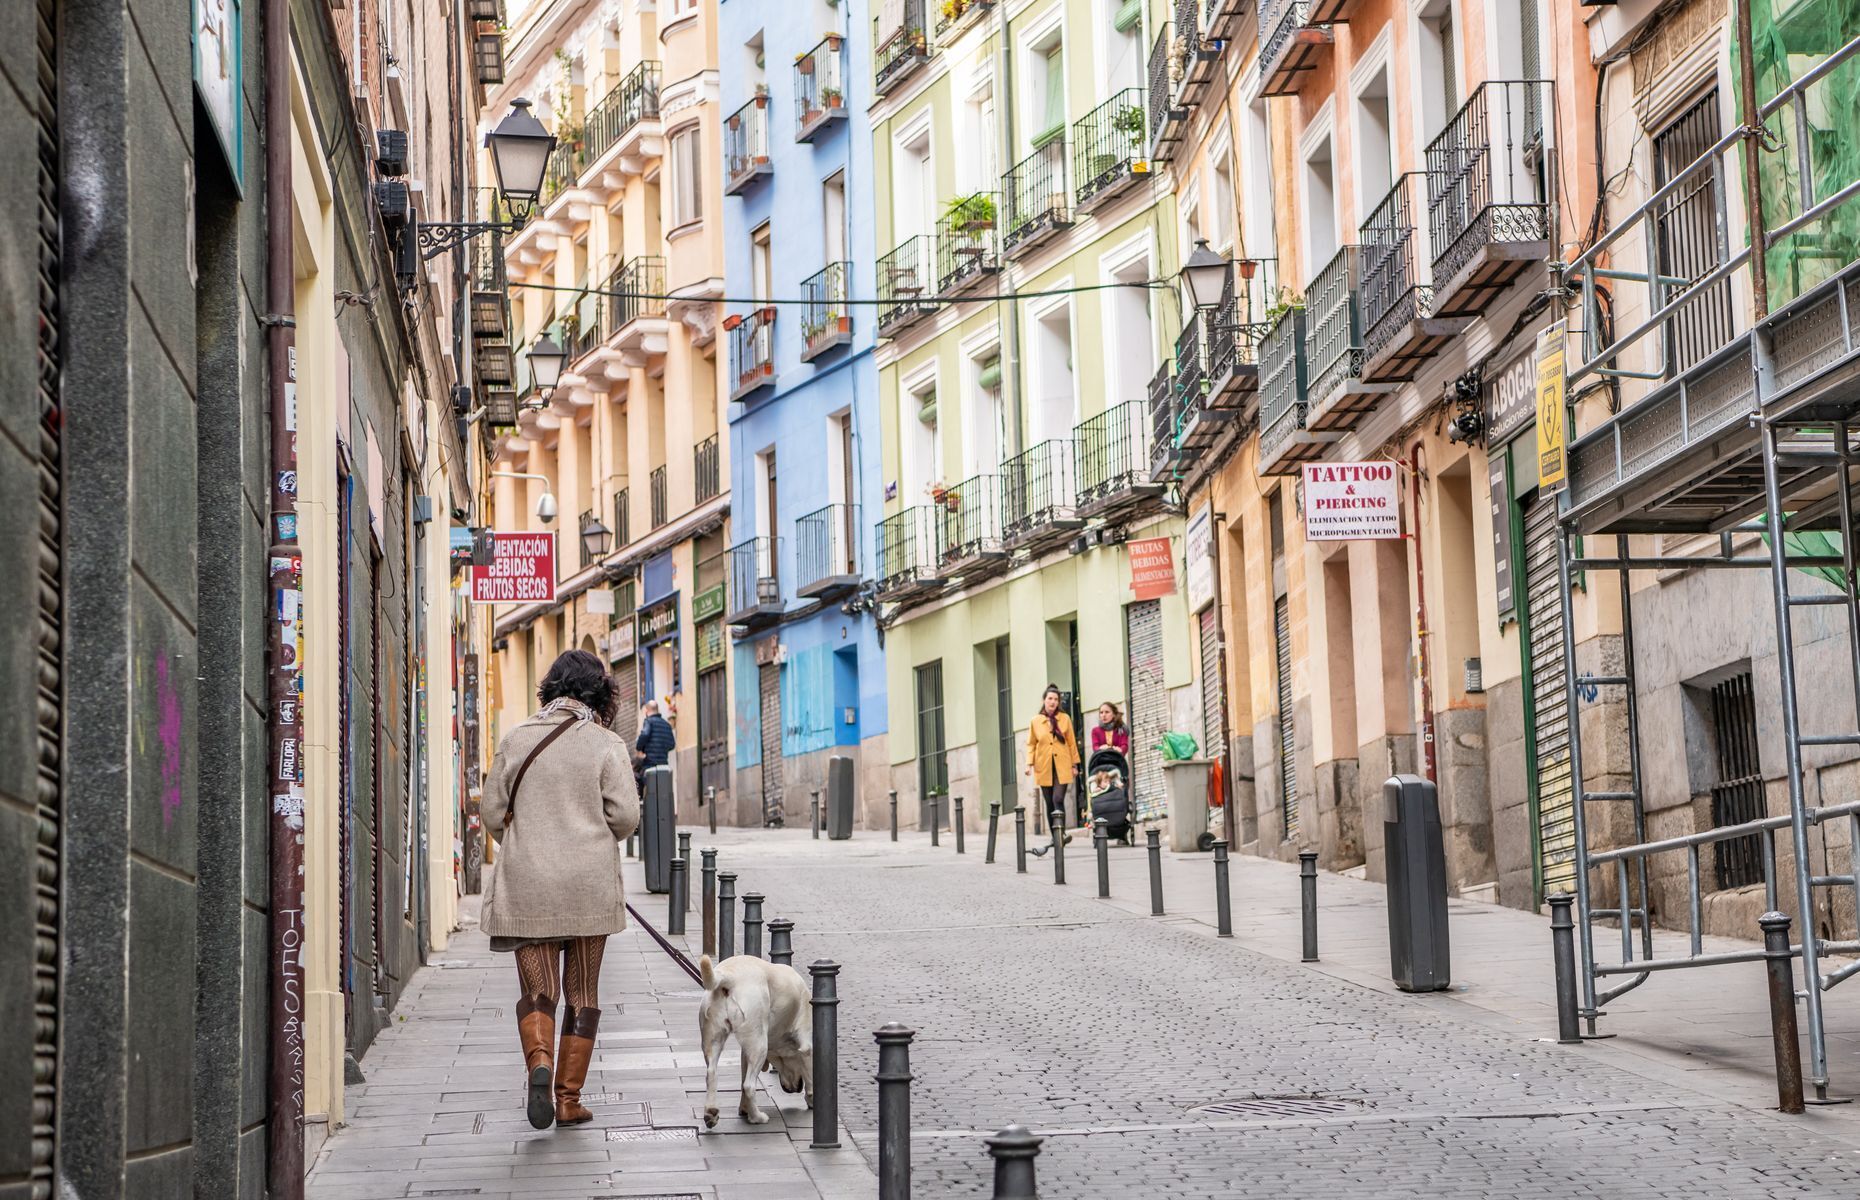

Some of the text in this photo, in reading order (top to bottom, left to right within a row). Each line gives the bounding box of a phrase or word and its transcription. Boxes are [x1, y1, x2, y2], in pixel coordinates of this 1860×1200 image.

[1489, 405, 1528, 440] Soluciones
[1308, 465, 1392, 483] TATTOO
[1345, 484, 1356, 496] &
[1316, 496, 1387, 510] PIERCING
[1309, 515, 1397, 524] ELIMINACION TATTOO
[1310, 528, 1398, 537] MICROPIGMENTACION
[494, 535, 548, 557] MENTACIÓN
[1130, 542, 1164, 555] FRUTAS
[488, 557, 536, 577] BEBIDAS
[1132, 555, 1170, 569] BEBIDAS
[477, 576, 548, 600] FRUTOS SECOS
[642, 620, 649, 636] LA
[650, 608, 676, 633] PORTILLA
[282, 739, 296, 779] FARLOPA
